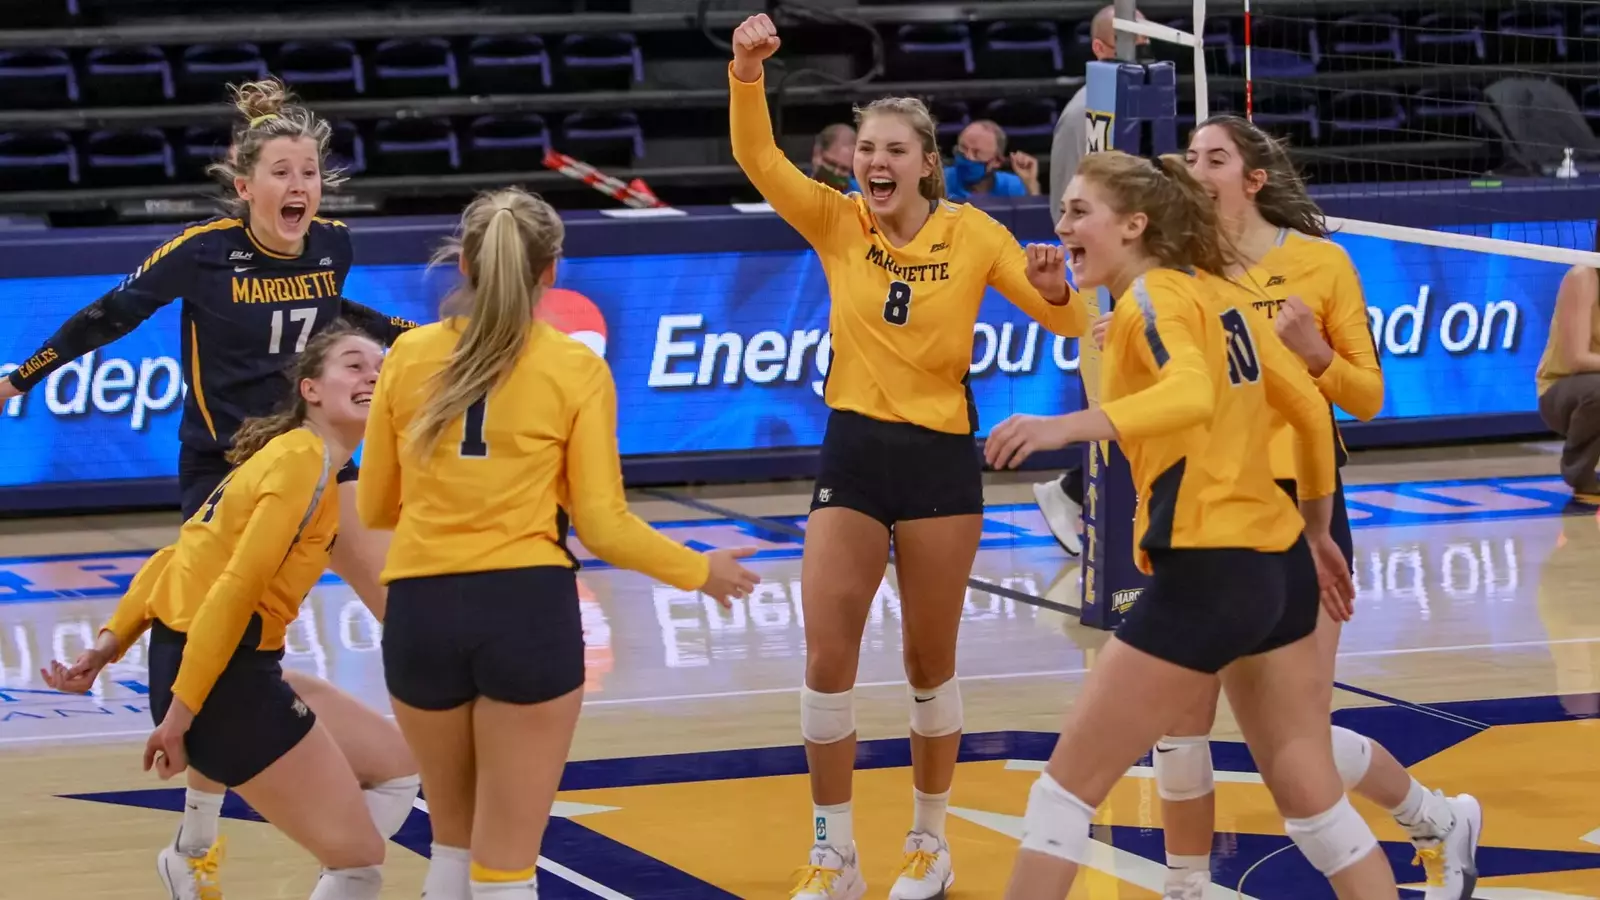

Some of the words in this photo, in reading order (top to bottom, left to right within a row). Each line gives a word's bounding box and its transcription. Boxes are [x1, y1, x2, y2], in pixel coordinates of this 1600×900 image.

[1085, 111, 1113, 155] M
[865, 244, 949, 282] MRETTE
[231, 270, 338, 304] MARQUETTE
[882, 280, 912, 328] 8
[268, 307, 318, 354] 17
[1366, 284, 1430, 355] nd
[1440, 300, 1518, 352] on
[18, 347, 59, 379] EAGLES
[969, 321, 1041, 374] ou
[45, 349, 188, 431] dep
[459, 390, 488, 459] 1
